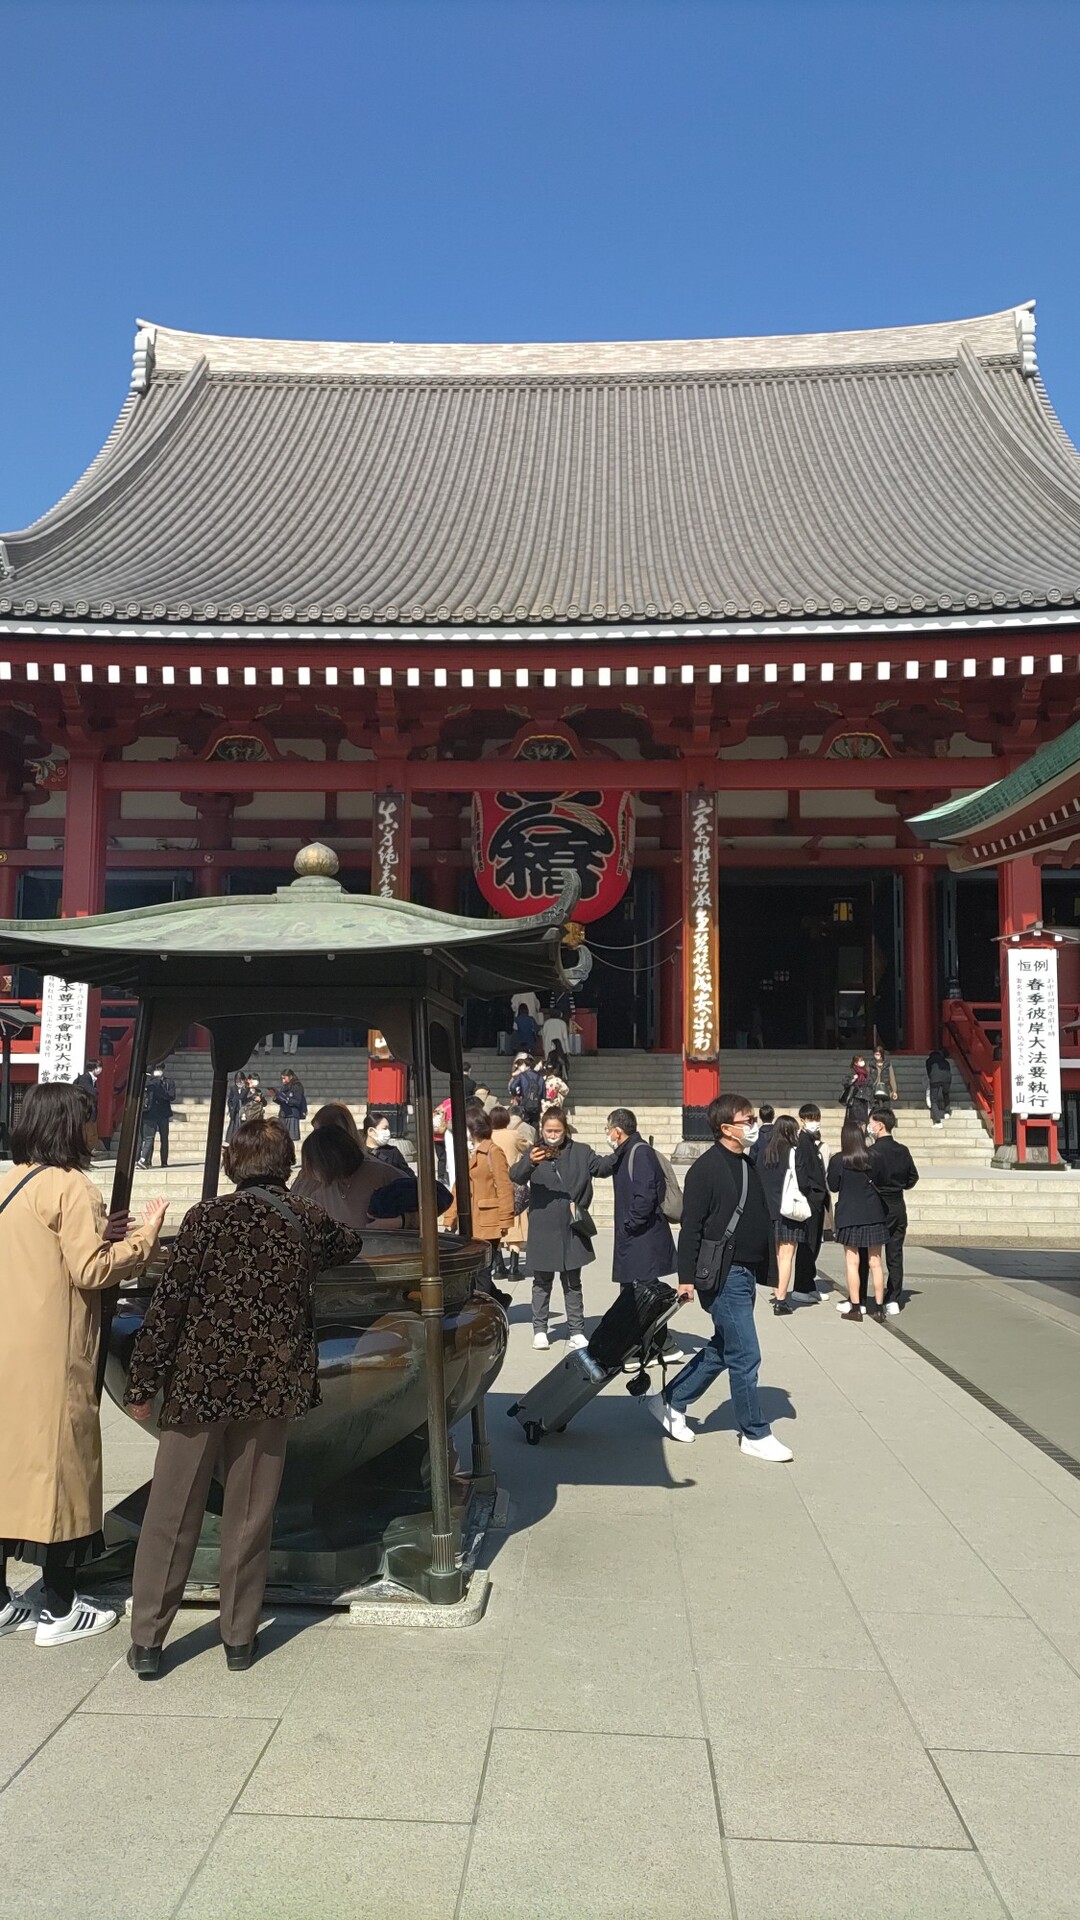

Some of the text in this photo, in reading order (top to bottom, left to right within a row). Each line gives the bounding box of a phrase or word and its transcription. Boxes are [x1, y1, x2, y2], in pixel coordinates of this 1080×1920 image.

[488, 790, 616, 901] 橋
[1018, 959, 1049, 972] 恒例
[1026, 978, 1049, 1107] 春季彼岸大法要執行
